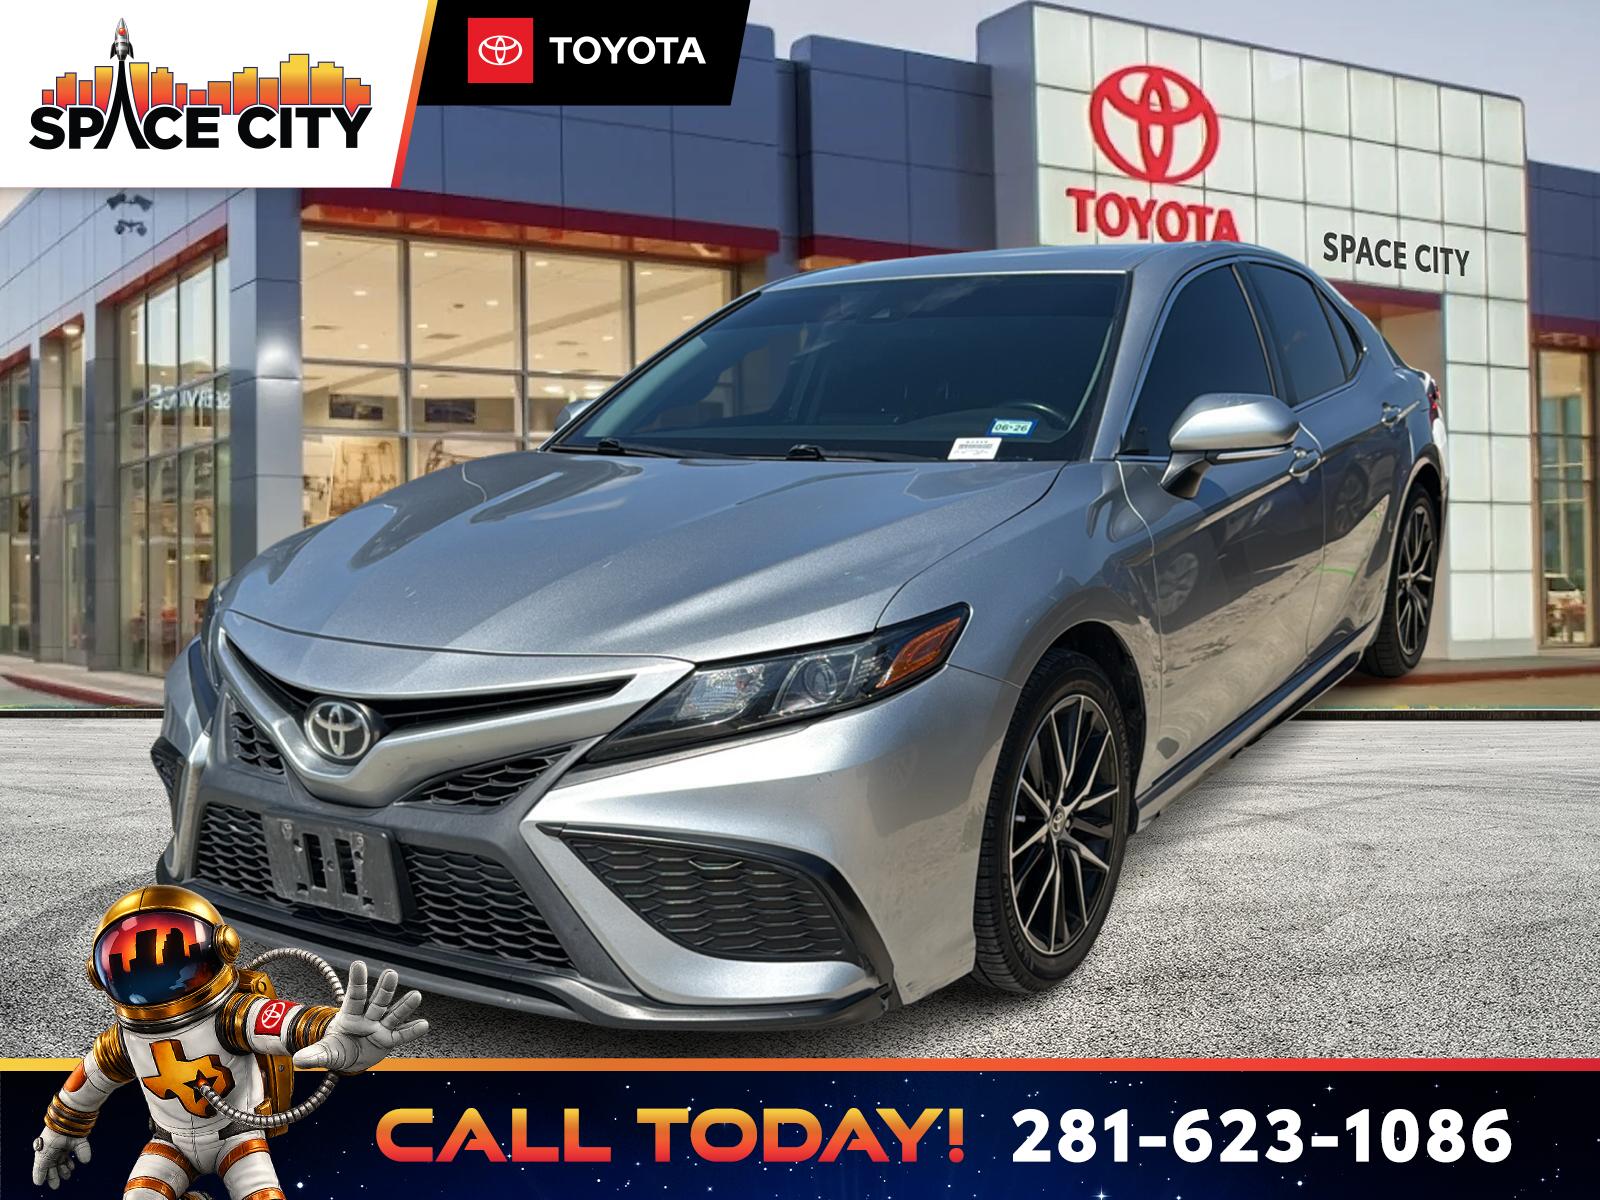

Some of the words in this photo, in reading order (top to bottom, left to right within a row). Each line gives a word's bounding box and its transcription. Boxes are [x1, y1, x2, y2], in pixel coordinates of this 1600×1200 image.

[1066, 187, 1240, 243] TOYOTA
[1323, 232, 1407, 269] SPACE
[1414, 244, 1470, 277] CITY
